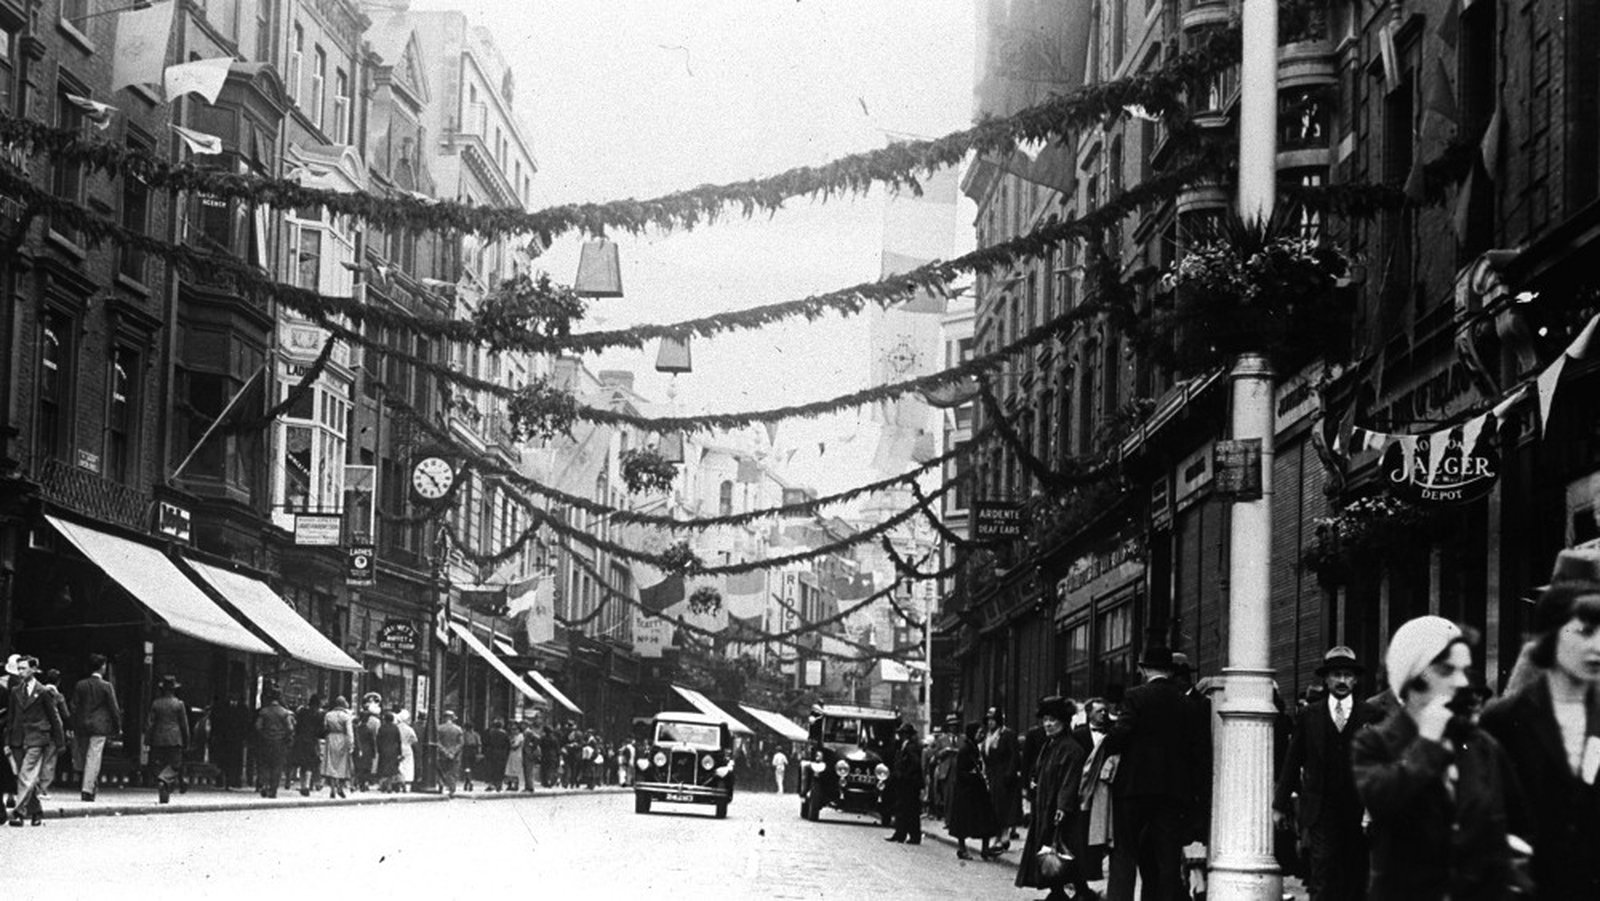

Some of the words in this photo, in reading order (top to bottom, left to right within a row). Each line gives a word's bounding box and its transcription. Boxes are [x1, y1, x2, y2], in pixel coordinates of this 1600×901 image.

[1421, 489, 1463, 500] DEPOT
[979, 509, 1020, 519] ARDENTE
[978, 525, 998, 534] DEAF
[999, 526, 1020, 535] EARS
[350, 548, 373, 557] LADIES
